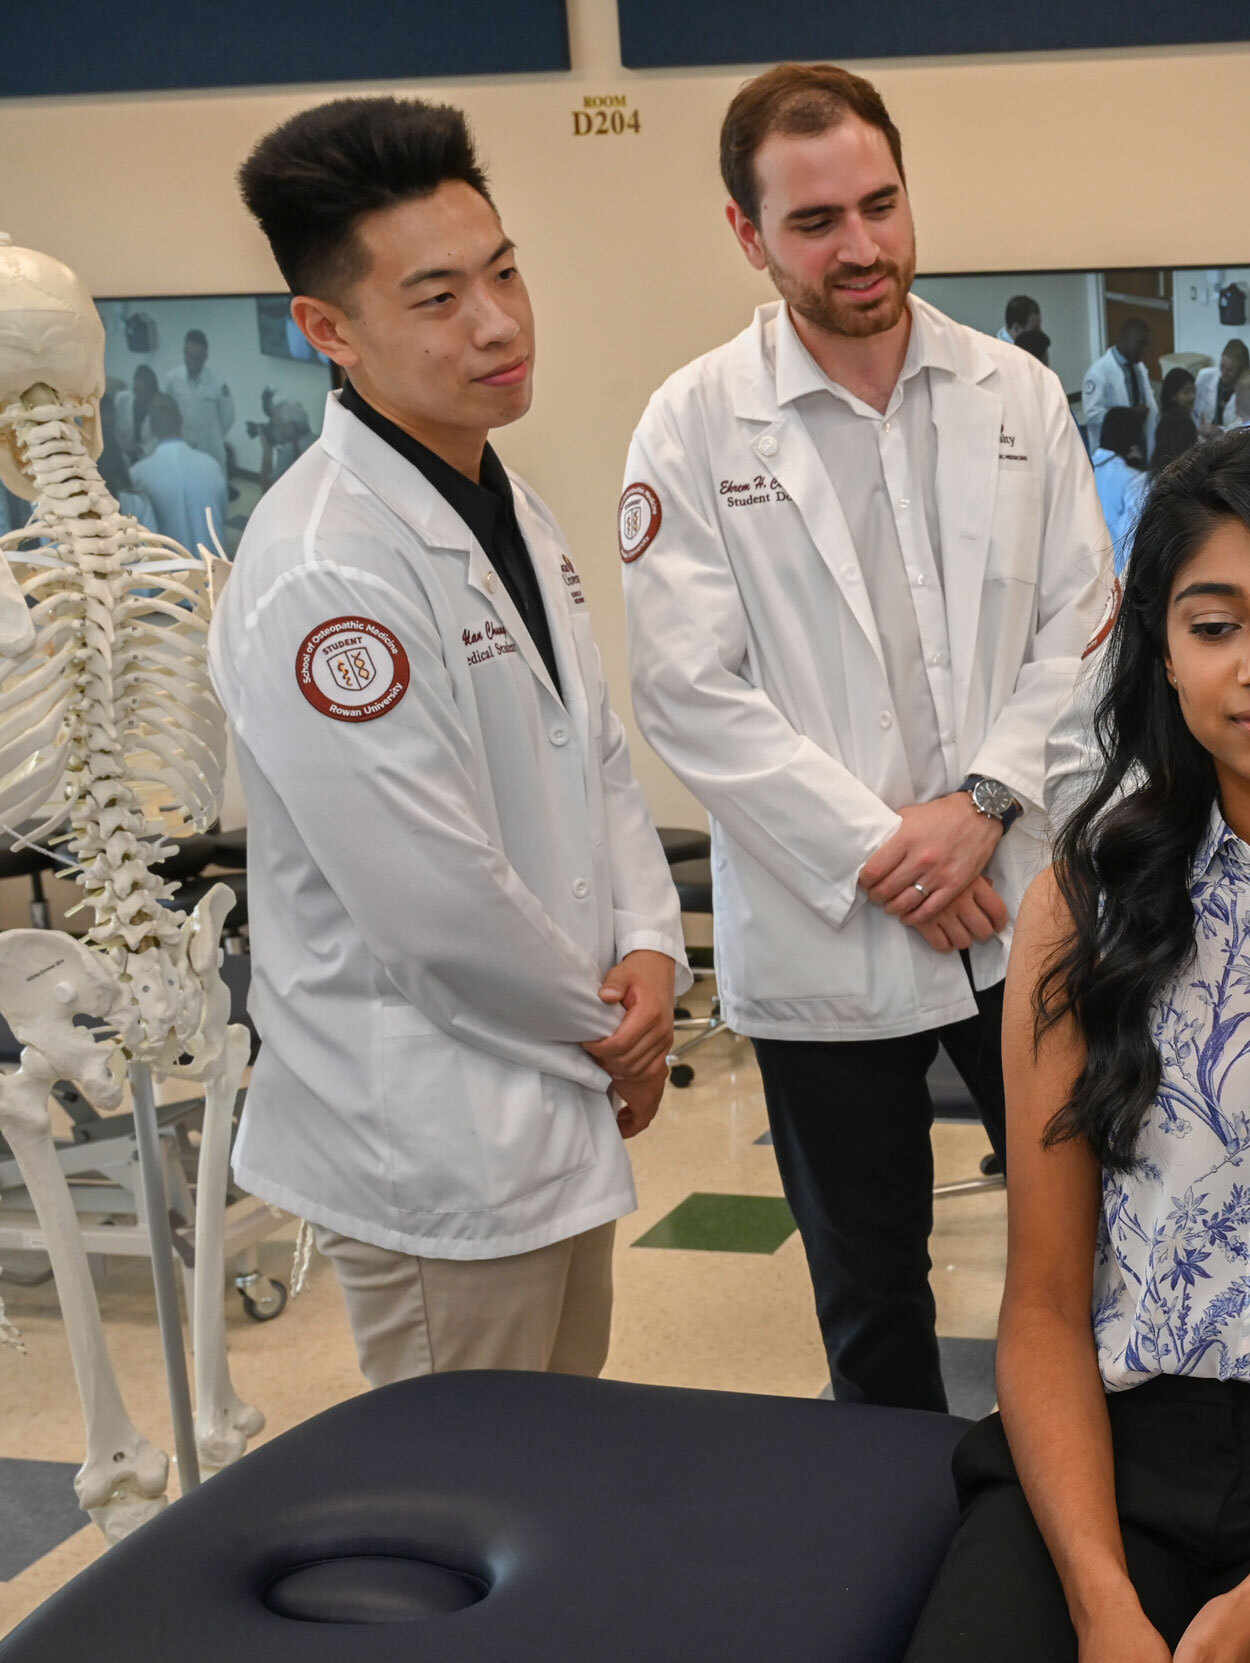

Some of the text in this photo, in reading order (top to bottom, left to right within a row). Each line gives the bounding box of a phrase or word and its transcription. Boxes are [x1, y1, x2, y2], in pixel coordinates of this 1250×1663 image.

[583, 95, 626, 108] ROOM
[571, 109, 641, 136] D204
[727, 493, 770, 507] Student
[301, 620, 399, 684] School of Osteopathic Medicine
[322, 636, 363, 656] STUDENT
[329, 681, 404, 717] Rowan University
